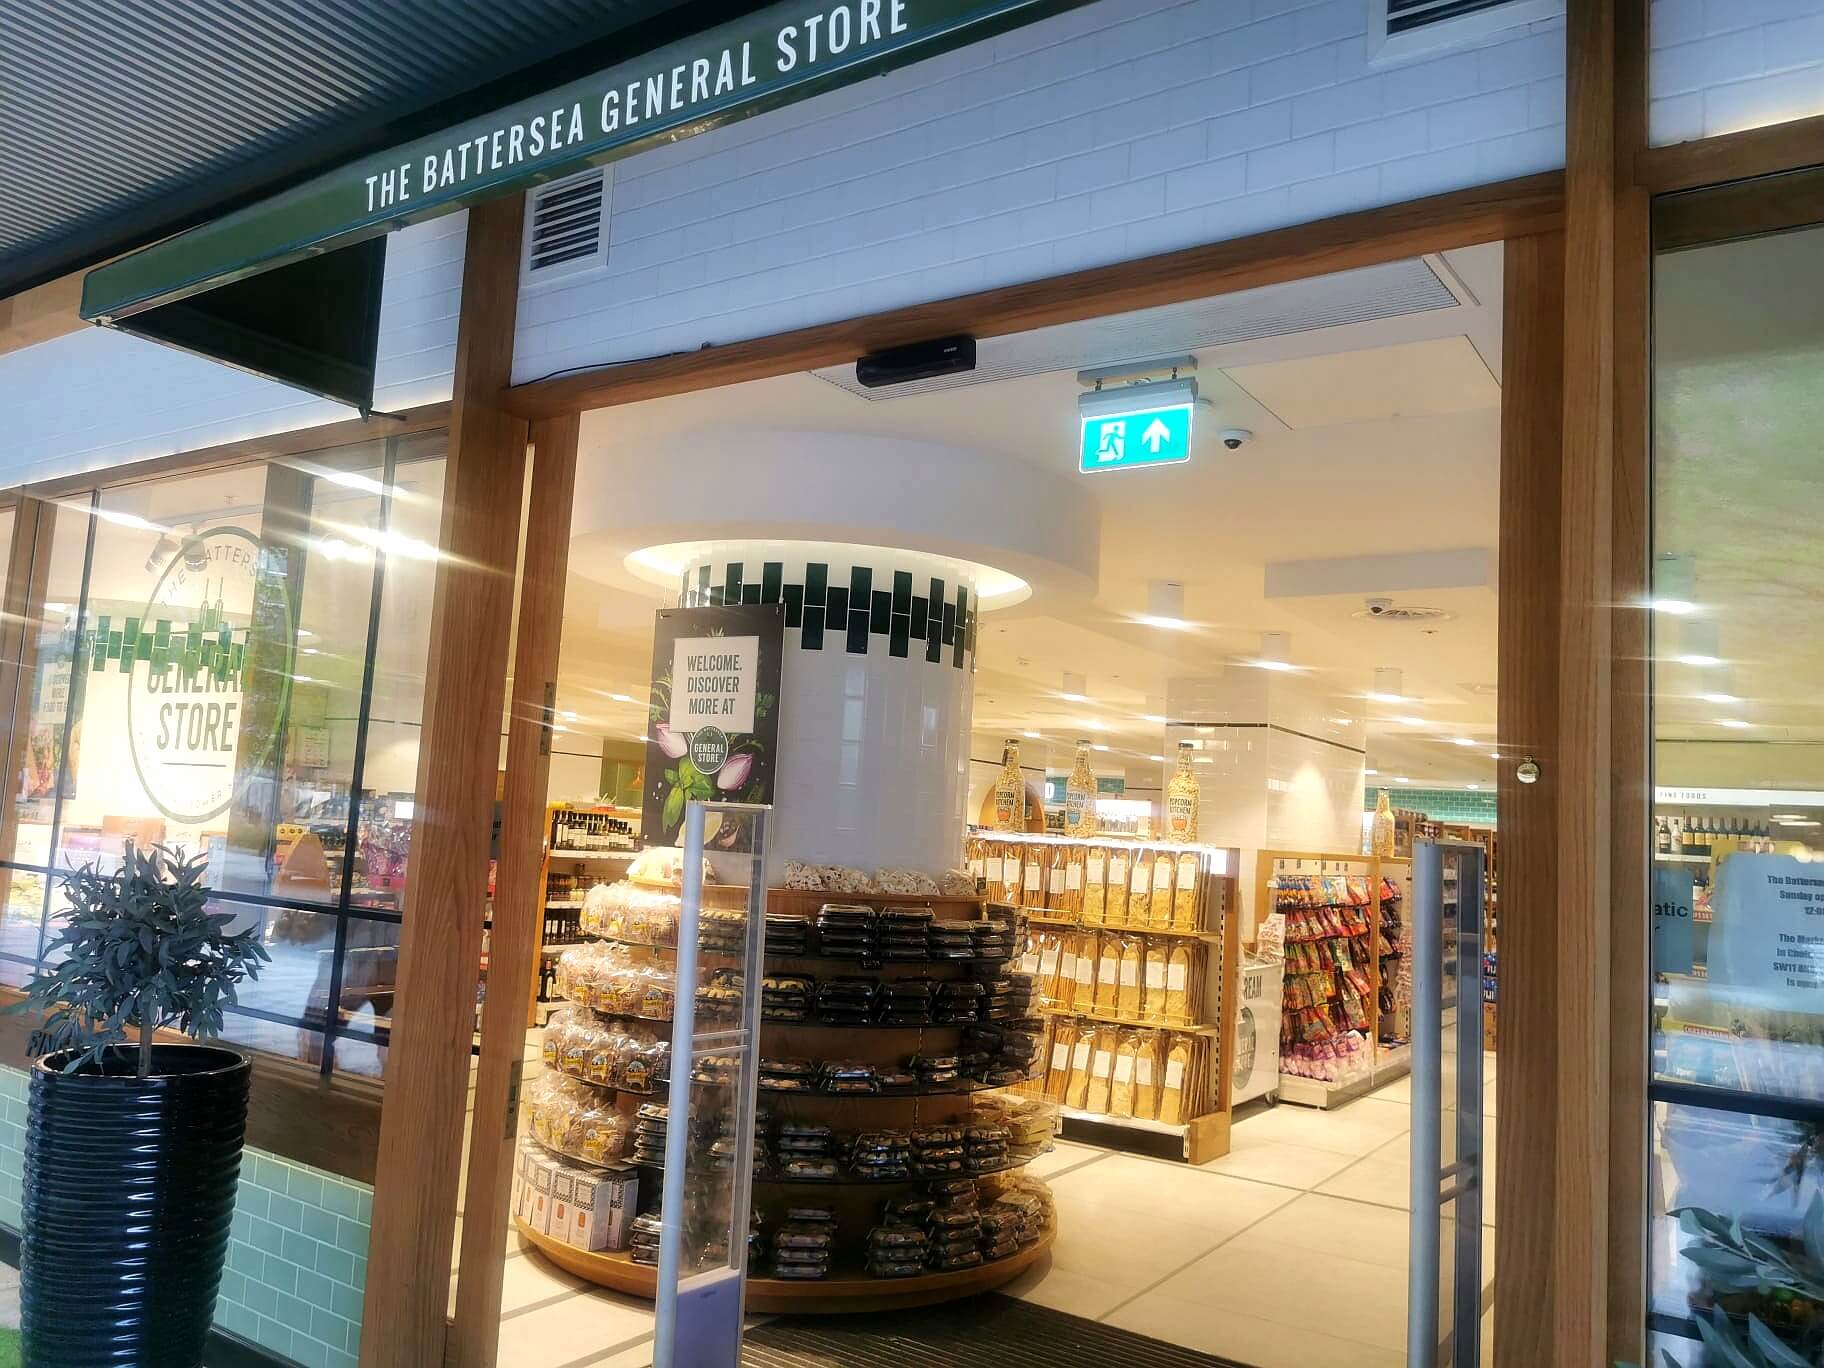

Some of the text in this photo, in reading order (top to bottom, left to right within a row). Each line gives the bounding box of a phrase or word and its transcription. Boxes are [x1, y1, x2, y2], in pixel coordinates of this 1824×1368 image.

[365, 0, 908, 212] THE BATTERSEA GENERAL STORE
[687, 654, 742, 672] WELCOME.
[687, 676, 740, 693] DISCOVER
[688, 698, 736, 715] MORE AT
[157, 703, 237, 751] STORE
[694, 743, 724, 753] GENERAL
[698, 753, 720, 763] STORE
[1654, 902, 1688, 917] atic
[1243, 975, 1262, 1000] REAM
